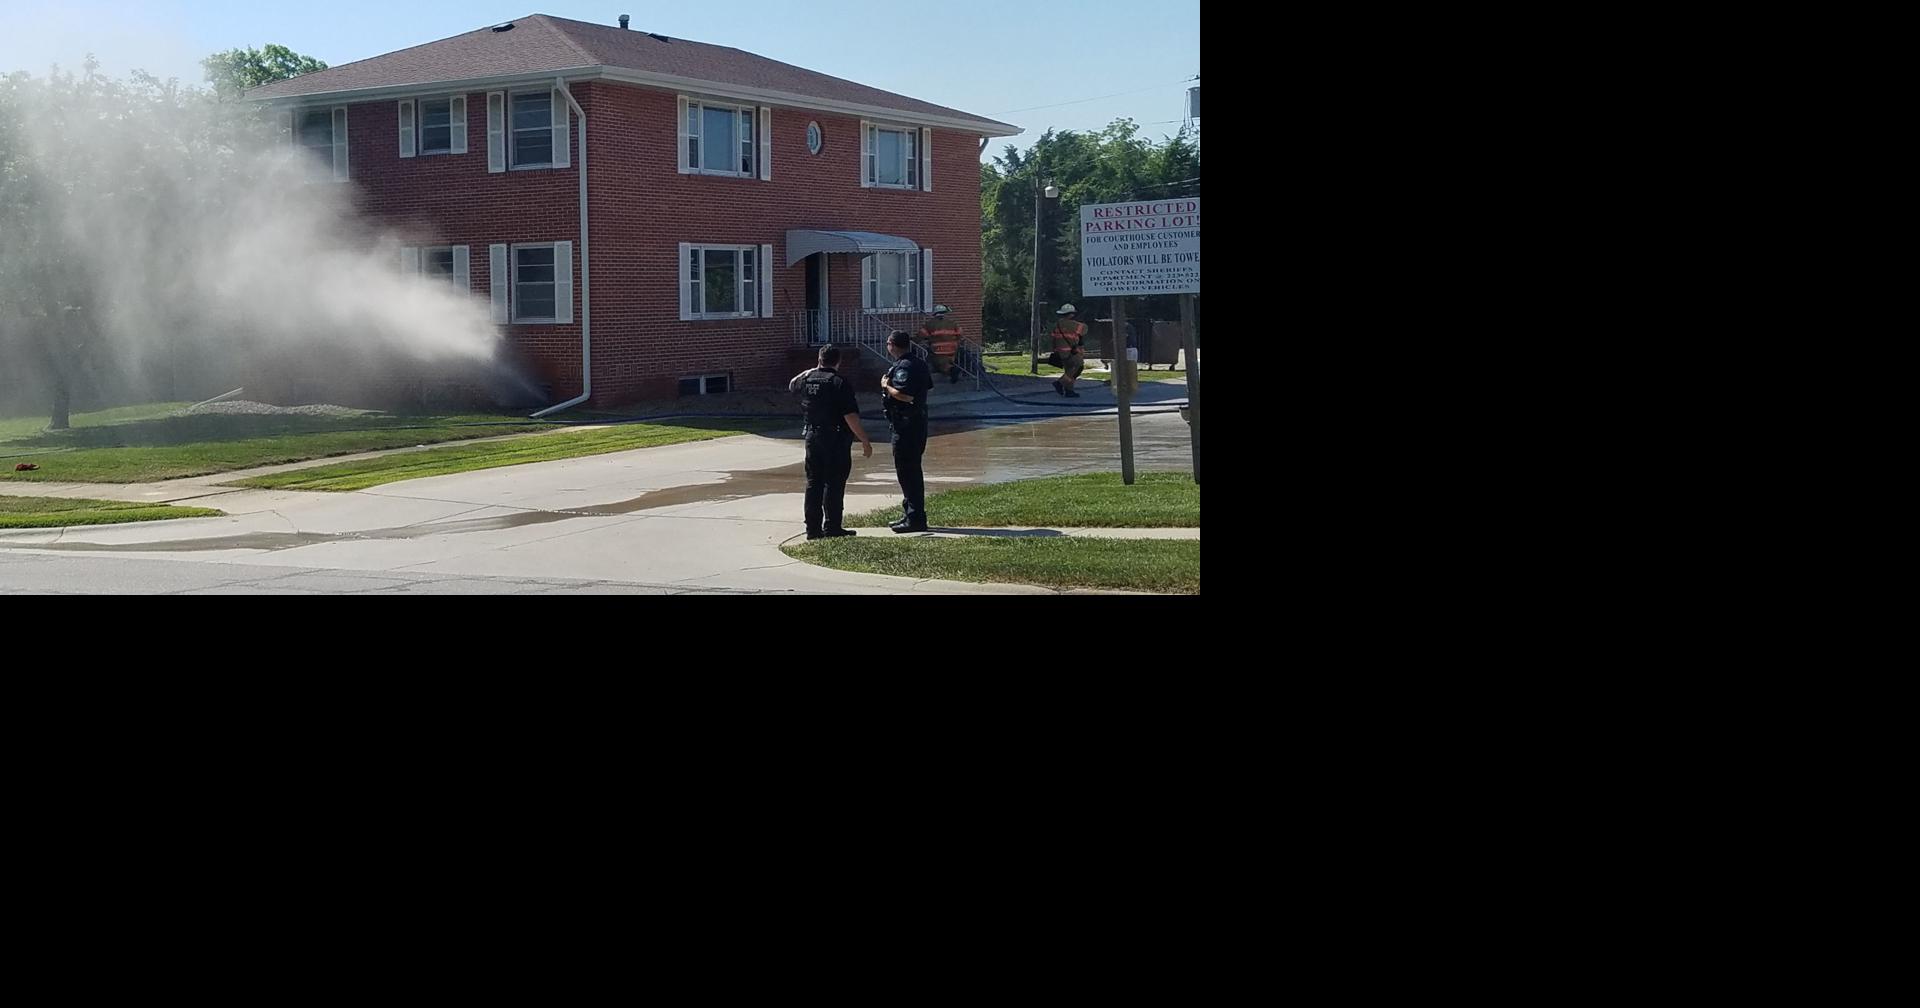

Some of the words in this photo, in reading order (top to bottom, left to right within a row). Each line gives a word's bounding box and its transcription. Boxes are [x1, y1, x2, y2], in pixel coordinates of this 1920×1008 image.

[1094, 202, 1196, 218] RESTRICTED
[1085, 218, 1156, 232] PARKING
[1162, 215, 1200, 228] LOT!
[1086, 236, 1102, 244] FOR
[1103, 232, 1156, 243] COURTHOUSE
[1131, 240, 1179, 250] EMPLOYEES
[1086, 255, 1134, 267] VIOLATORS
[1136, 254, 1159, 265] WILL
[1161, 253, 1173, 264] BE
